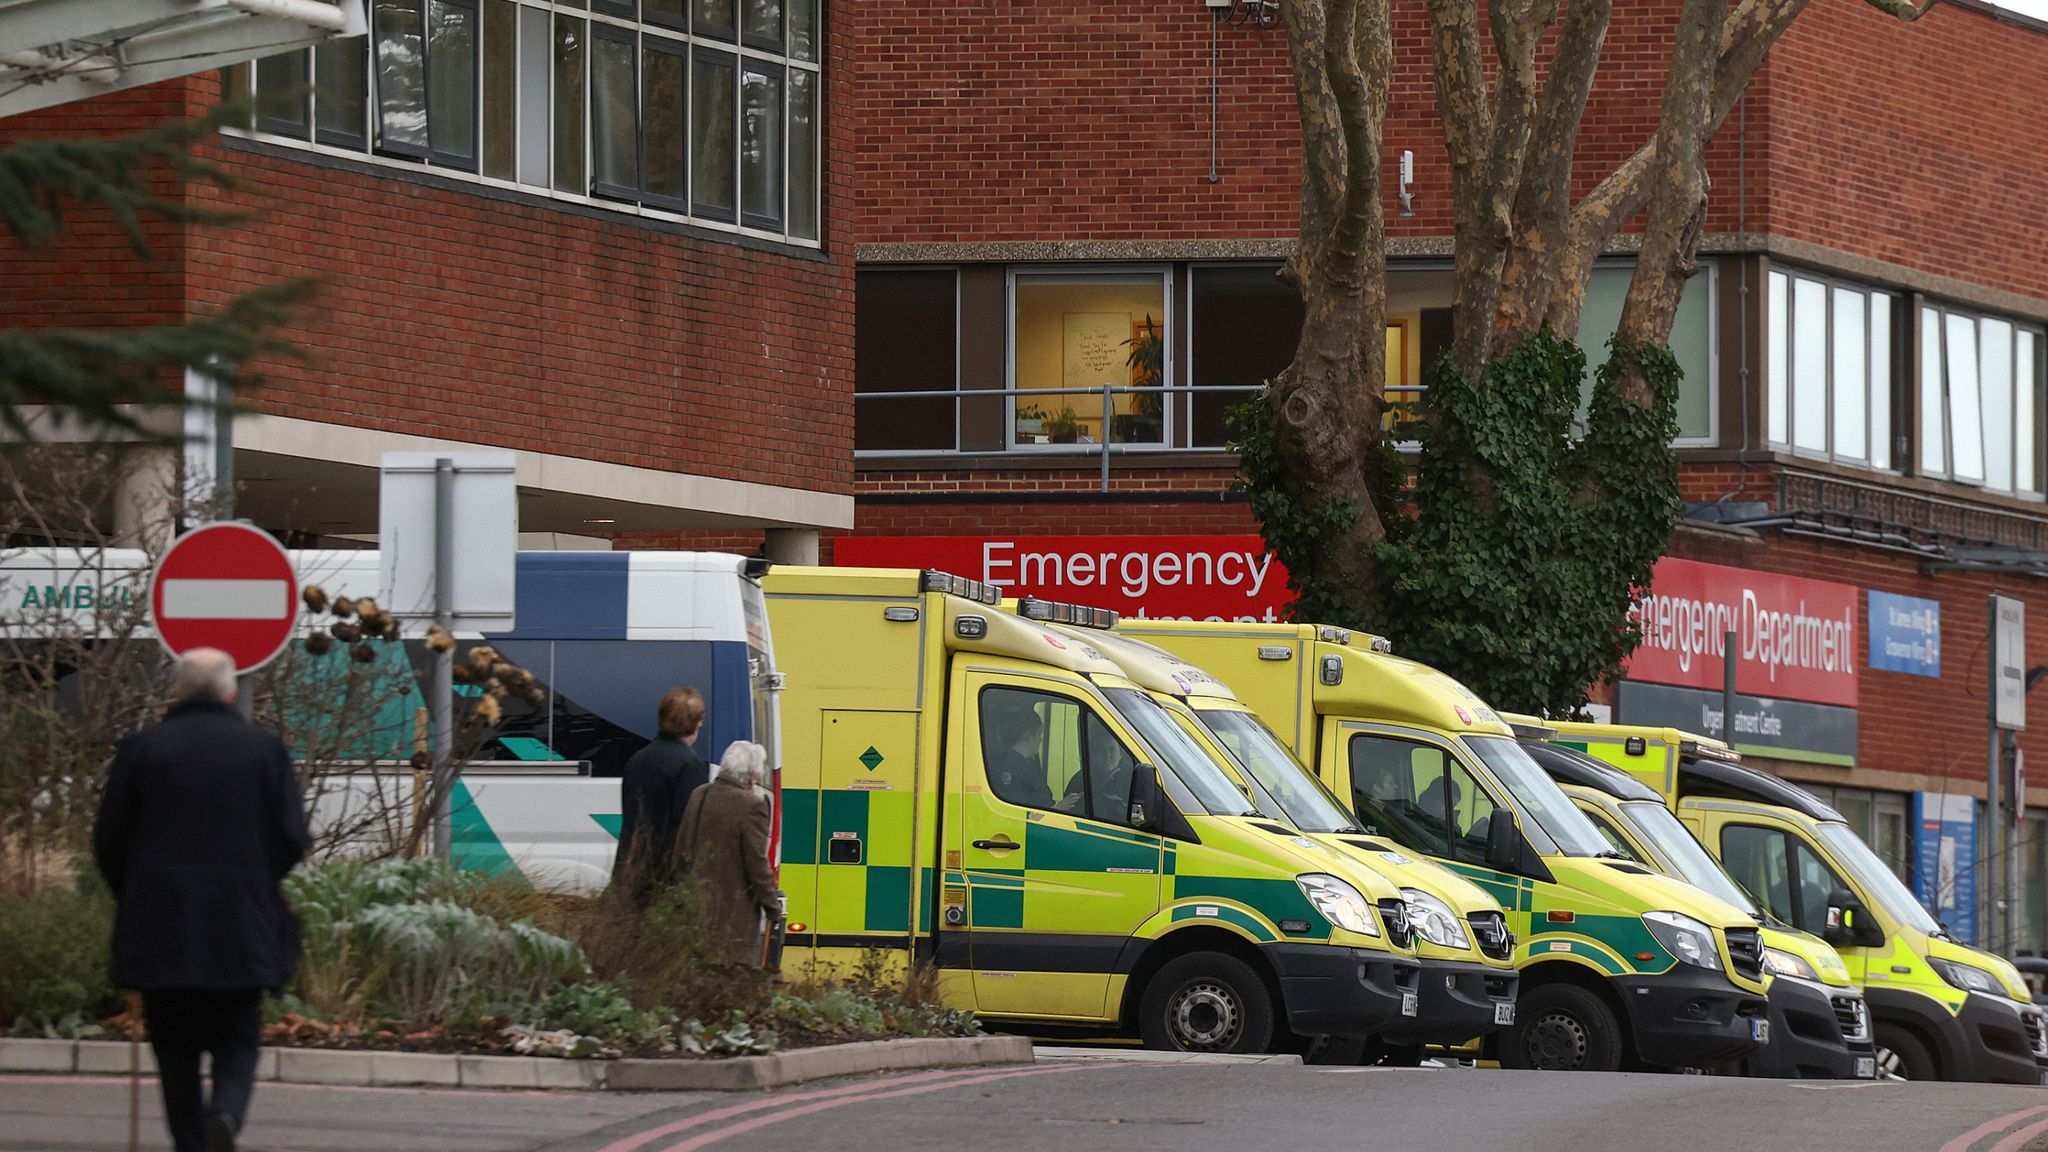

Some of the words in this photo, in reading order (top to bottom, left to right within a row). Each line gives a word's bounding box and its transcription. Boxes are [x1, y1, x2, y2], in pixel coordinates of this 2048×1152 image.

[983, 542, 1273, 597] Emergency
[1743, 588, 1853, 683] Department
[1735, 710, 1759, 733] atment
